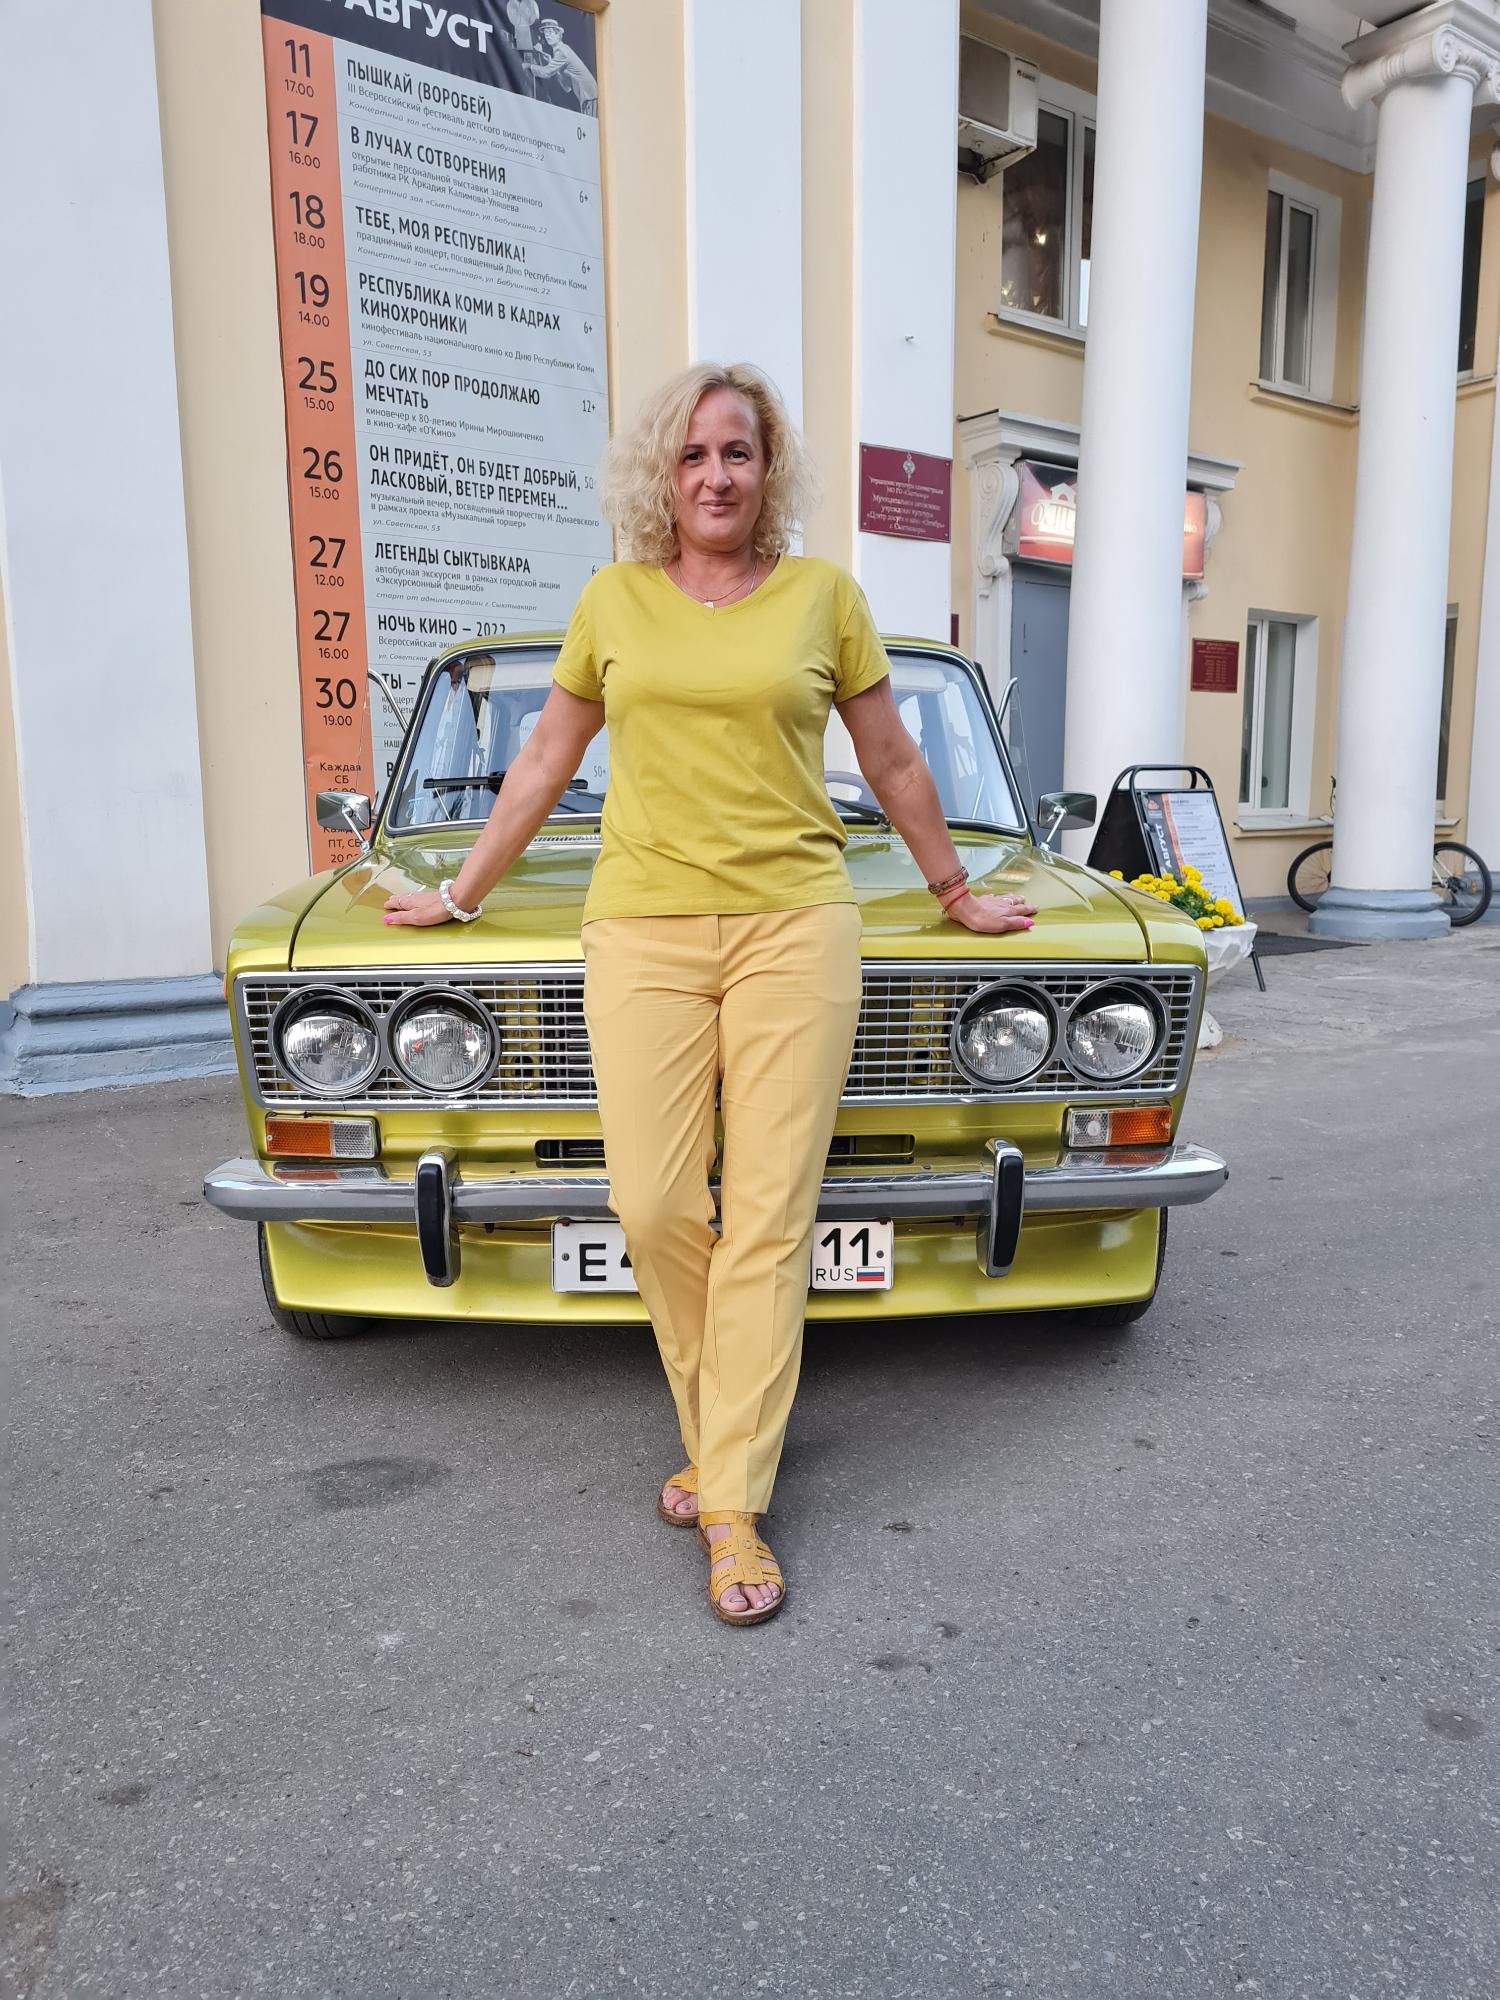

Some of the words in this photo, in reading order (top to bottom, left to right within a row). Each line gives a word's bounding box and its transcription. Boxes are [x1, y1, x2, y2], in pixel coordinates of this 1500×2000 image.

[285, 39, 311, 78] 11
[284, 79, 315, 98] 17.00
[347, 59, 412, 95] ПЫШКАЙ
[418, 80, 492, 122] (ВОРОБЕЙ)
[349, 101, 403, 122] Концертный
[359, 87, 421, 113] Всероссийский
[423, 106, 465, 126] фестиваль
[466, 117, 500, 136] детского
[503, 130, 566, 154] видеотворчества
[286, 110, 319, 148] 17
[576, 126, 586, 141] 0+
[289, 150, 321, 169] 16.00
[351, 126, 360, 144] В
[365, 130, 412, 159] ЛУЧАХ
[417, 145, 506, 184] СОТВОРЕНИЯ
[352, 151, 391, 169] открытие
[393, 161, 450, 184] персональной
[453, 178, 489, 194] выставки
[490, 188, 543, 208] заслуженного
[352, 163, 396, 181] работника
[399, 174, 409, 185] РК
[412, 178, 446, 194] Аркадия
[449, 185, 519, 213] Калимова-Уляшева
[353, 179, 408, 200] Концертный
[409, 194, 423, 203] зал
[579, 190, 588, 204] 6+
[289, 191, 325, 229] 18
[294, 232, 325, 249] 18.00
[355, 206, 395, 234] ТЕБЕ,
[399, 217, 430, 240] МОЯ
[435, 225, 526, 263] РЕСПУБЛИКА!
[357, 246, 412, 264] Концертный
[414, 260, 427, 268] зал
[357, 231, 412, 250] праздничный
[414, 244, 449, 261] концерт,
[451, 253, 504, 272] посвященный
[505, 264, 522, 276] Дню
[524, 269, 567, 287] Республики
[568, 280, 588, 291] Коми
[581, 260, 591, 274] 6+
[294, 271, 329, 308] 19
[359, 272, 451, 308] РЕСПУБЛИКА
[455, 293, 493, 318] КОМИ
[498, 303, 506, 320] В
[511, 306, 560, 331] КАДРАХ
[299, 311, 330, 328] 14.00
[361, 297, 467, 335] КИНОХРОНИКИ
[583, 320, 593, 335] 6+
[361, 322, 422, 341] кинофестиваль
[424, 333, 482, 352] национального
[484, 346, 503, 357] кино
[505, 350, 513, 359] ко
[515, 350, 532, 363] Дню
[533, 353, 575, 370] Республики
[576, 361, 595, 374] Коми
[423, 348, 432, 357] 53
[298, 356, 337, 393] 25
[365, 359, 385, 379] ДО
[390, 363, 418, 384] СИХ
[422, 369, 449, 389] ПОР
[454, 374, 540, 405] ПРОДОЛЖАЮ
[304, 397, 335, 412] 15.00
[366, 383, 429, 409] МЕЧТАТЬ
[582, 399, 596, 413] 12+
[365, 407, 409, 424] киновечер
[411, 414, 417, 422] к
[418, 412, 457, 428] 80-летию
[459, 420, 484, 434] Ирины
[486, 425, 544, 442] Мирошниченко
[366, 418, 371, 426] в
[374, 420, 417, 434] кино-кафе
[303, 447, 343, 482] 26
[369, 445, 389, 463] ОН
[395, 447, 454, 474] ПРИДЁТ,
[457, 457, 475, 475] ОН
[479, 460, 519, 481] БУДЕТ
[524, 467, 581, 492] ДОБРЫЙ,
[309, 486, 340, 500] 15.00
[371, 469, 452, 498] ЛАСКОВЫЙ,
[456, 480, 494, 501] ВЕТЕР
[499, 486, 568, 510] ПЕРЕМЕН...
[370, 492, 425, 506] музыкальный
[426, 499, 452, 511] вечер,
[454, 502, 504, 516] посвященный
[506, 508, 545, 522] творчеству
[547, 513, 554, 522] И.
[556, 514, 599, 528] Дунаевского
[378, 503, 407, 514] рамках
[409, 507, 439, 519] проекта
[441, 509, 494, 525] «Музыкальный
[496, 518, 526, 529] торшер»
[431, 524, 441, 532] 53
[309, 535, 346, 569] 27
[375, 543, 439, 566] ЛЕГЕНДЫ
[443, 549, 531, 574] СЫКТЫВКАРА
[315, 574, 345, 587] 12.00
[375, 565, 420, 578] автобусная
[421, 570, 461, 582] экскурсия
[465, 574, 470, 582] в
[472, 575, 498, 586] рамках
[499, 577, 537, 589] городской
[539, 581, 561, 590] акции
[375, 575, 441, 590] «Экскурсионный
[444, 581, 484, 592] флешмоб»
[376, 592, 404, 600] старт
[313, 609, 350, 642] 27
[378, 614, 415, 633] НОЧЬ
[419, 618, 457, 635] КИНО
[319, 647, 349, 660] 16.00
[378, 635, 437, 647] Всероссийская
[315, 677, 357, 709] 30
[323, 715, 353, 726] 19.00
[320, 762, 361, 772] Каждая
[334, 775, 349, 784] СБ
[593, 765, 606, 778] 50+
[328, 839, 344, 849] ПТ,
[1155, 823, 1172, 868] АВГУСТ
[821, 1228, 869, 1266] 11
[815, 1268, 854, 1281] RUS
